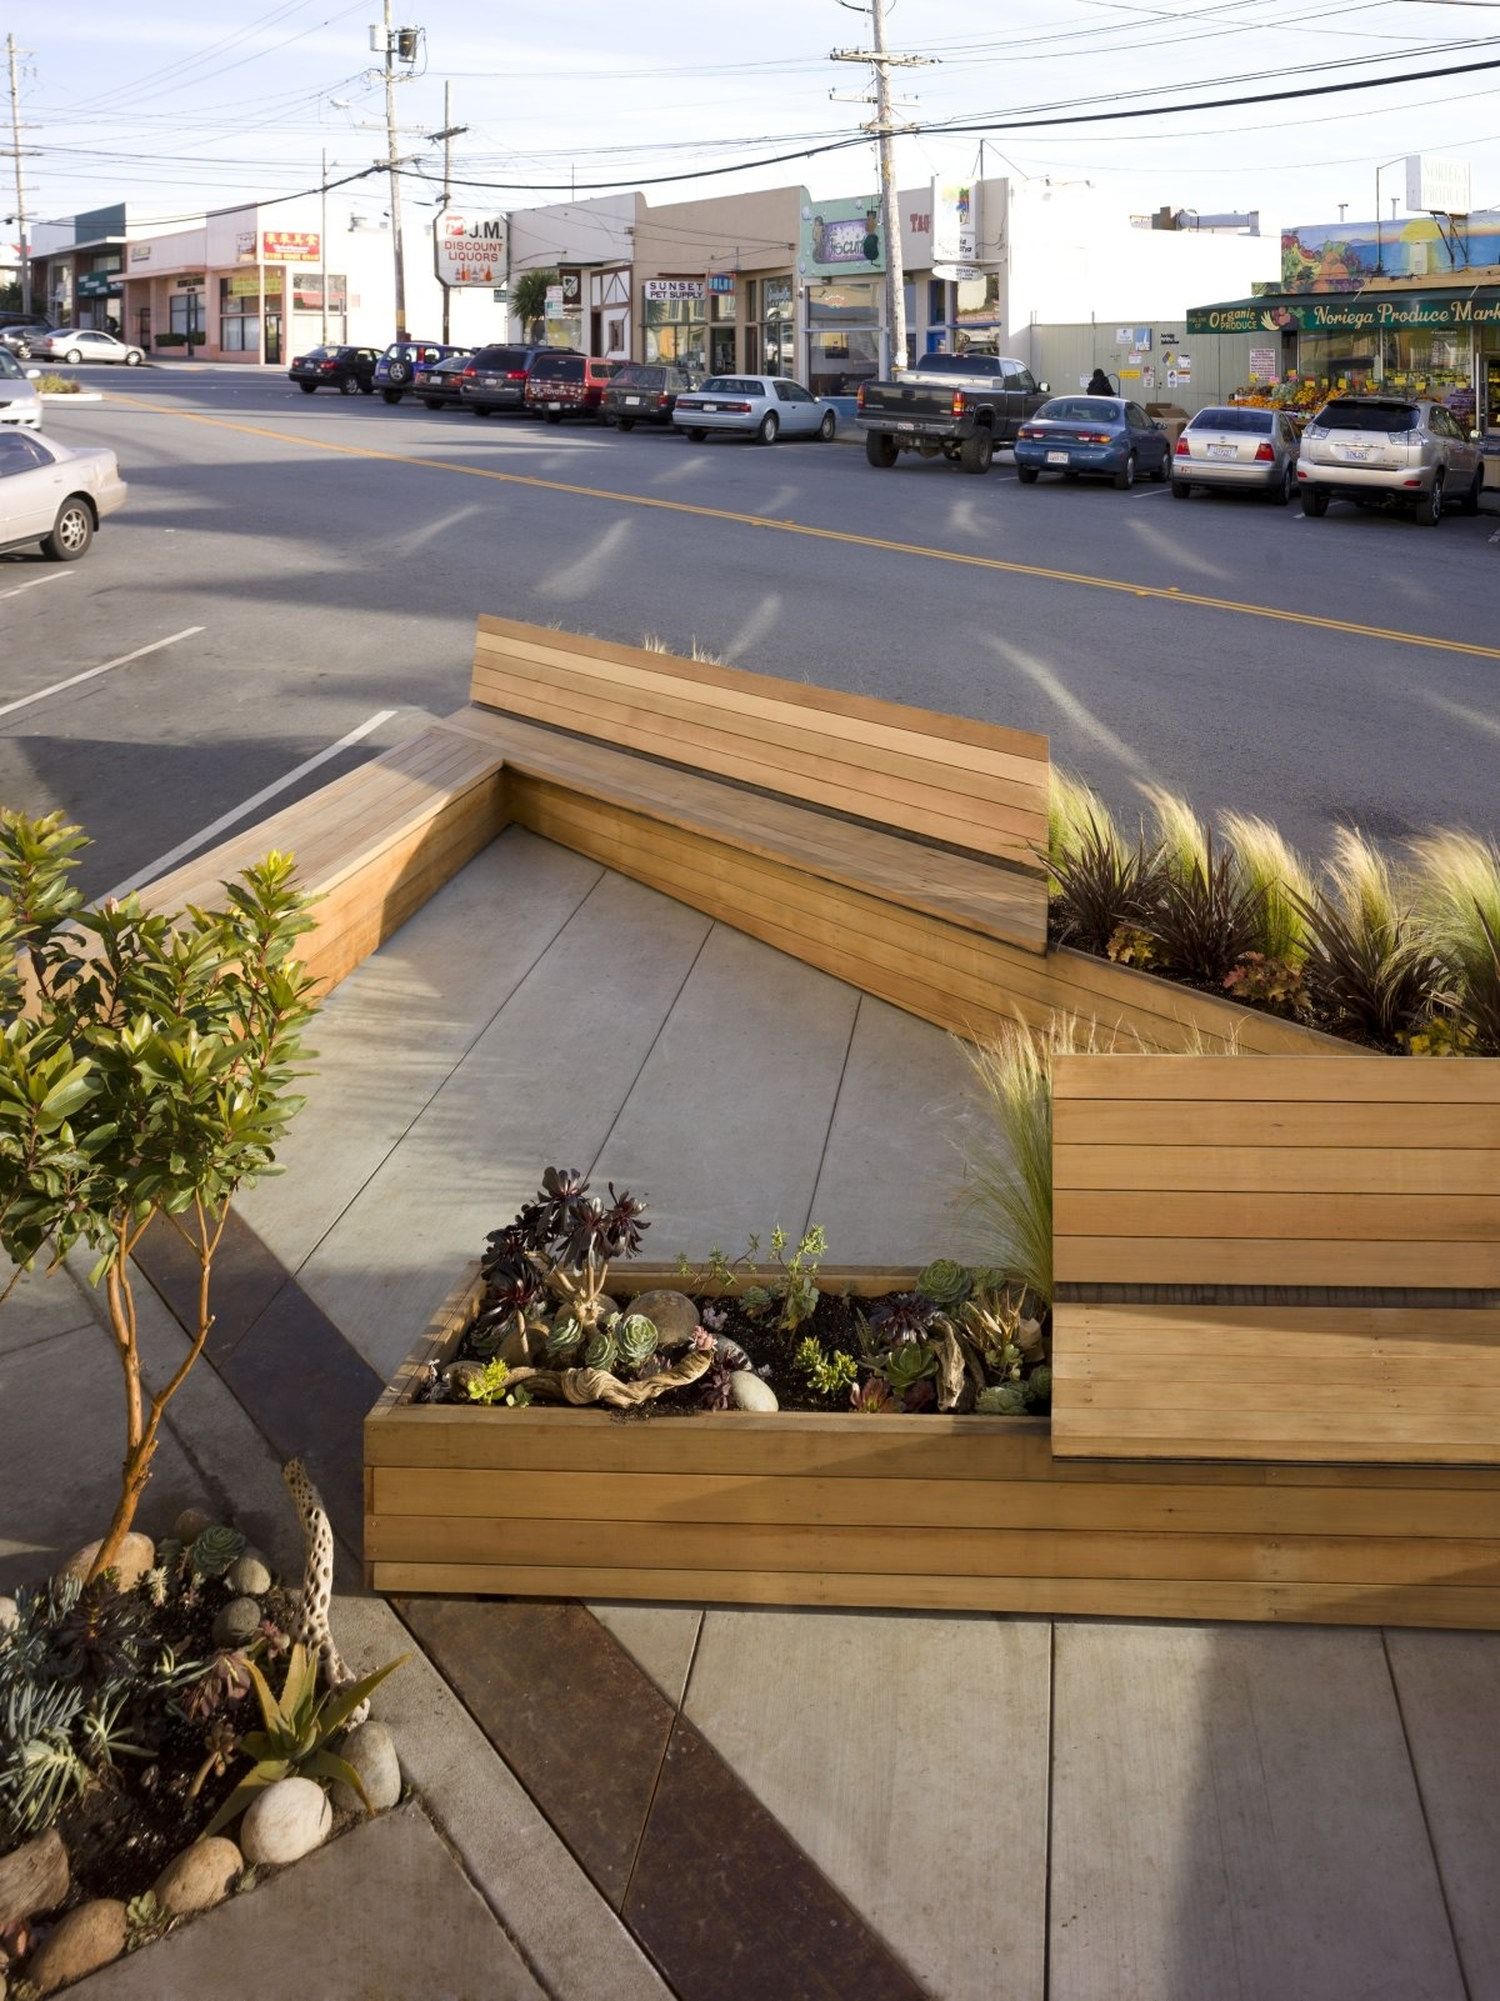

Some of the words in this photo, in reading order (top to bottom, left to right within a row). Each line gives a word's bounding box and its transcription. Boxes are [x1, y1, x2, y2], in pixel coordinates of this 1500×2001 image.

[469, 220, 504, 240] J.M.
[444, 240, 504, 252] DISCOUNT
[448, 251, 498, 262] LIQUORS
[649, 281, 703, 291] SUNSET
[650, 290, 667, 299] PET
[669, 290, 704, 299] SUPPLY
[1209, 307, 1256, 329] Organic
[1313, 304, 1375, 329] Noriega
[1377, 302, 1450, 324] Produce
[1220, 320, 1258, 330] PRODUCE
